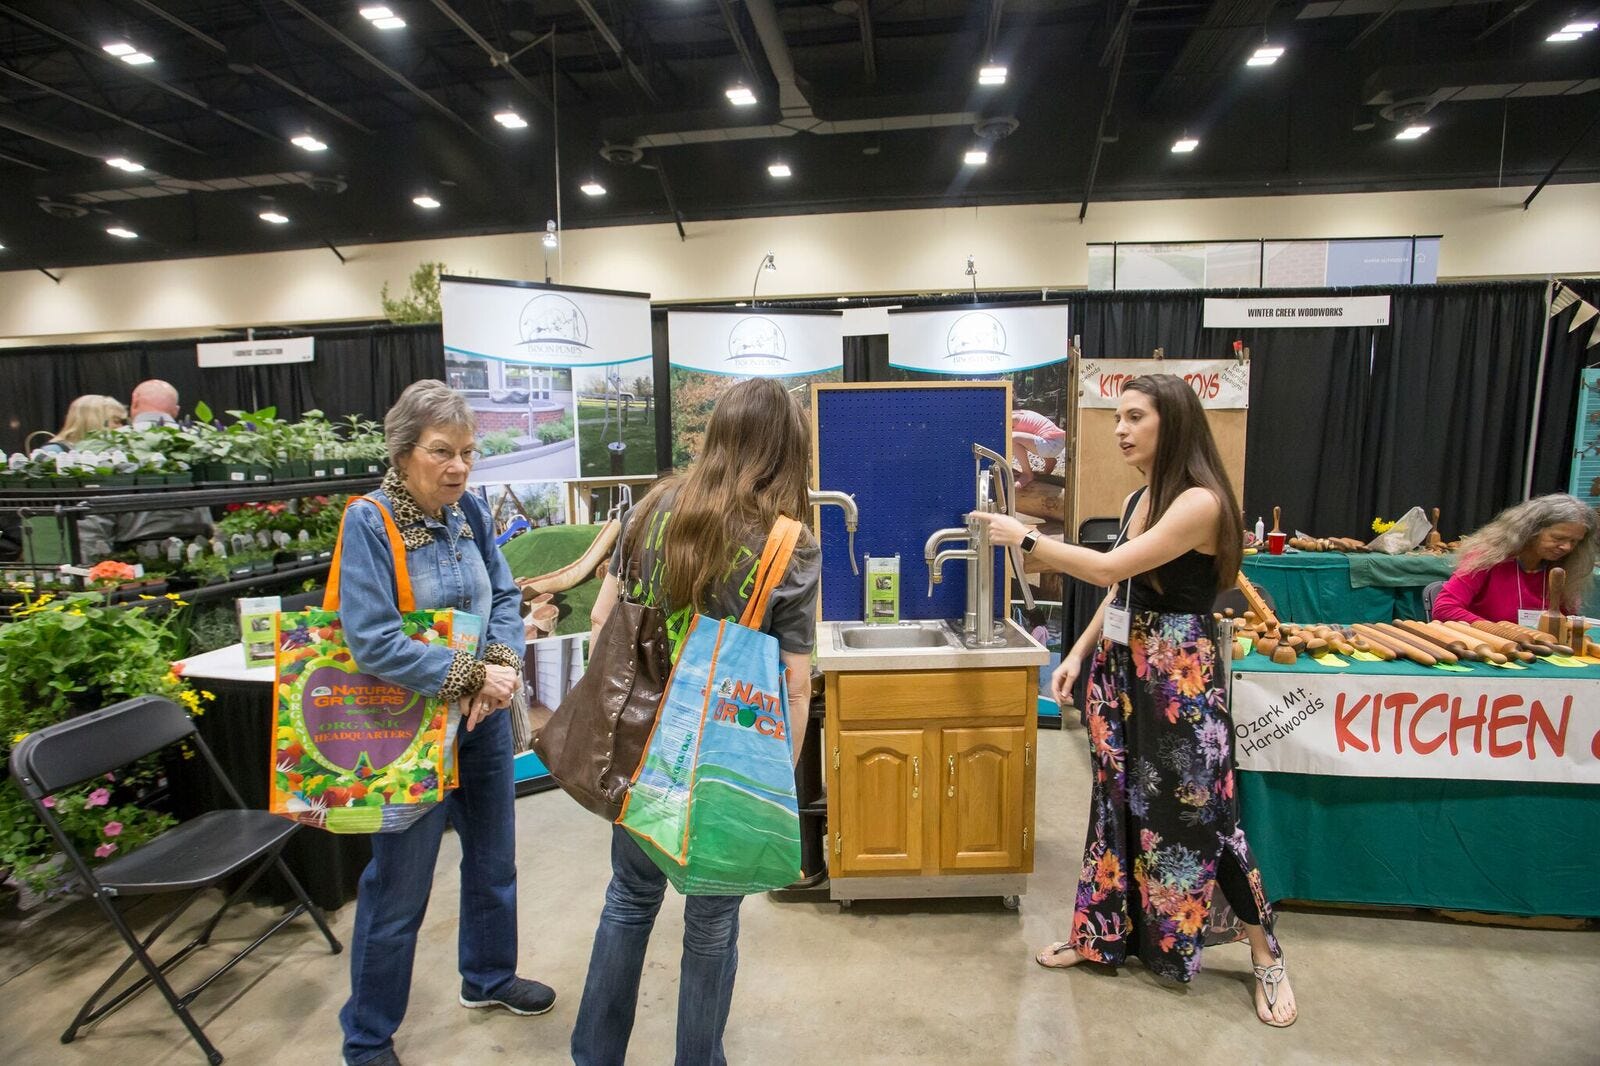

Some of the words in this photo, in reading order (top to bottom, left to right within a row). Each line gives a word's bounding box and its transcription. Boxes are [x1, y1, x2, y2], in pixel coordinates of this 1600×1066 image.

[1248, 308, 1274, 318] WINTER
[1275, 308, 1296, 317] CREEK
[1298, 307, 1344, 317] WOODWORKS
[332, 684, 406, 696] NATURAL
[1235, 704, 1284, 739] Ozark
[1282, 687, 1313, 709] Mt.
[319, 720, 400, 732] ORGANIC
[1240, 697, 1325, 757] Hardwoods
[1334, 692, 1574, 760] KITCHEN
[313, 730, 413, 743] HEADQUARTERS
